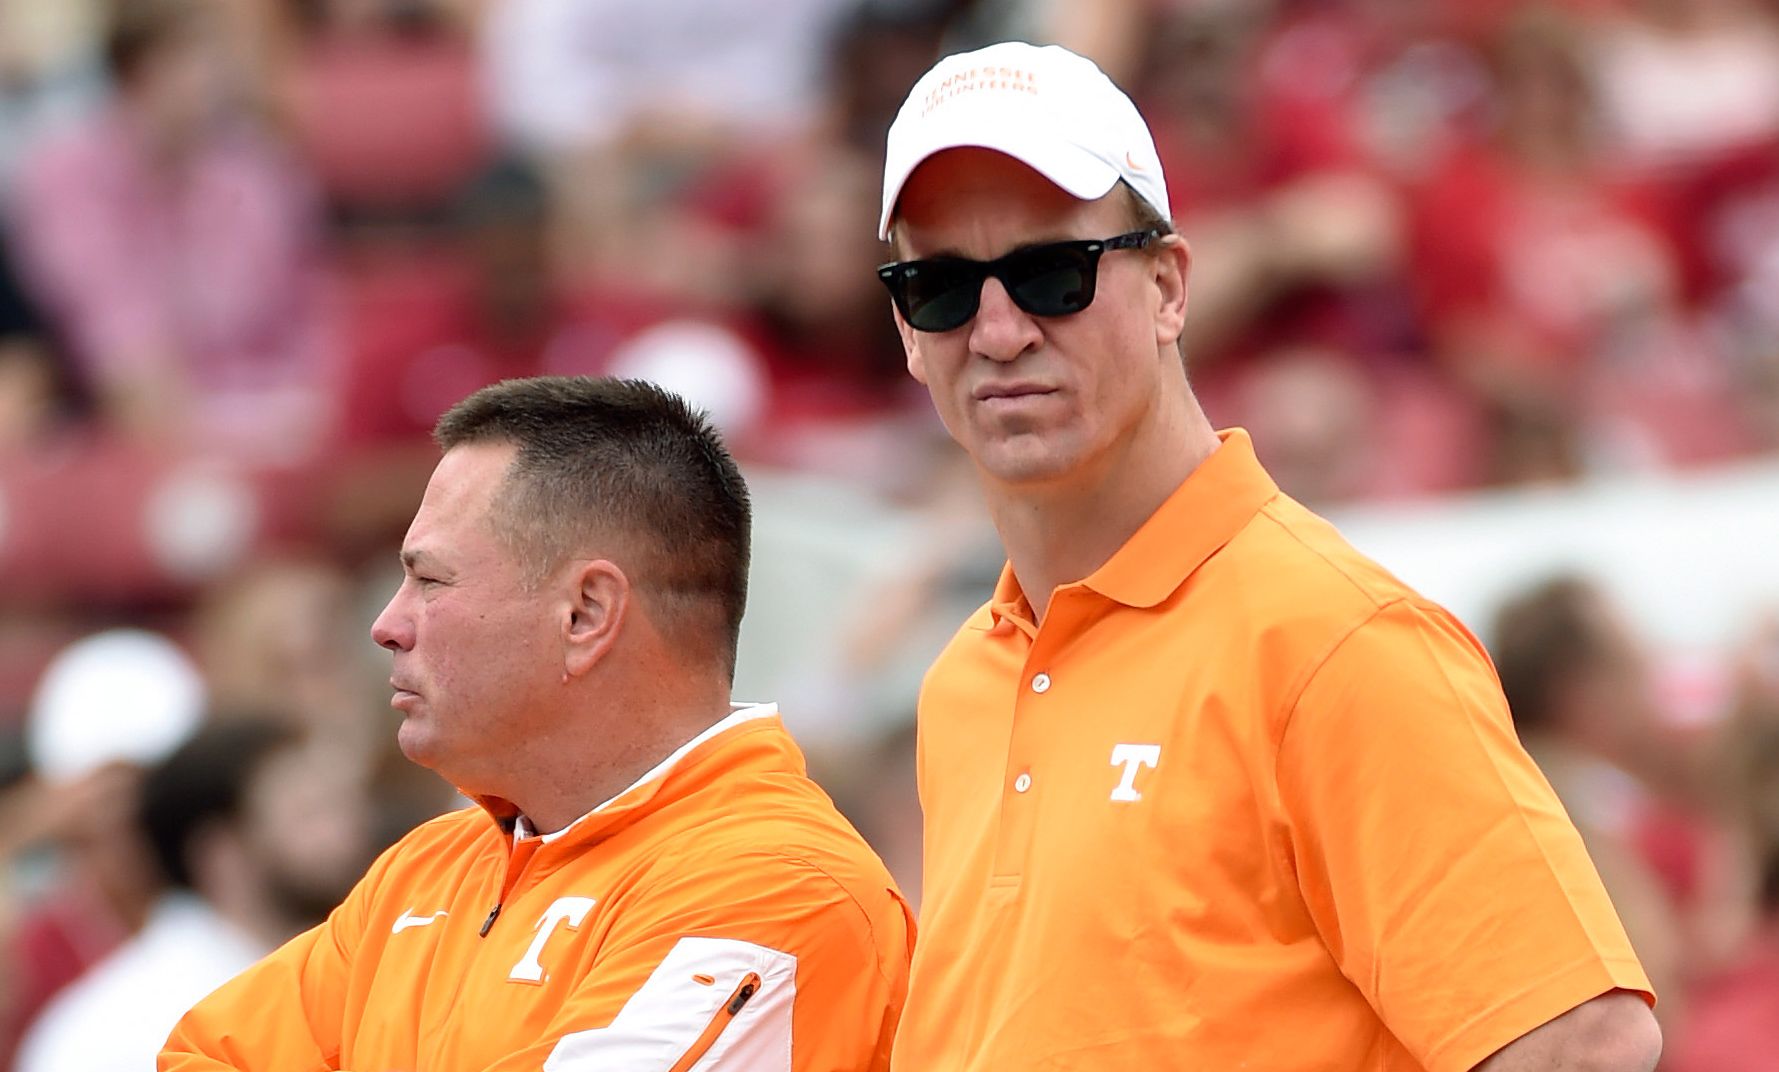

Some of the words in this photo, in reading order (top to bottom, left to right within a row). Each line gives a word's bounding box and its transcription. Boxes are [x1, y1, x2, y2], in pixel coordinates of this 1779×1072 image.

[920, 79, 1040, 119] UNTEERS
[1109, 743, 1162, 801] T
[506, 896, 594, 984] T
